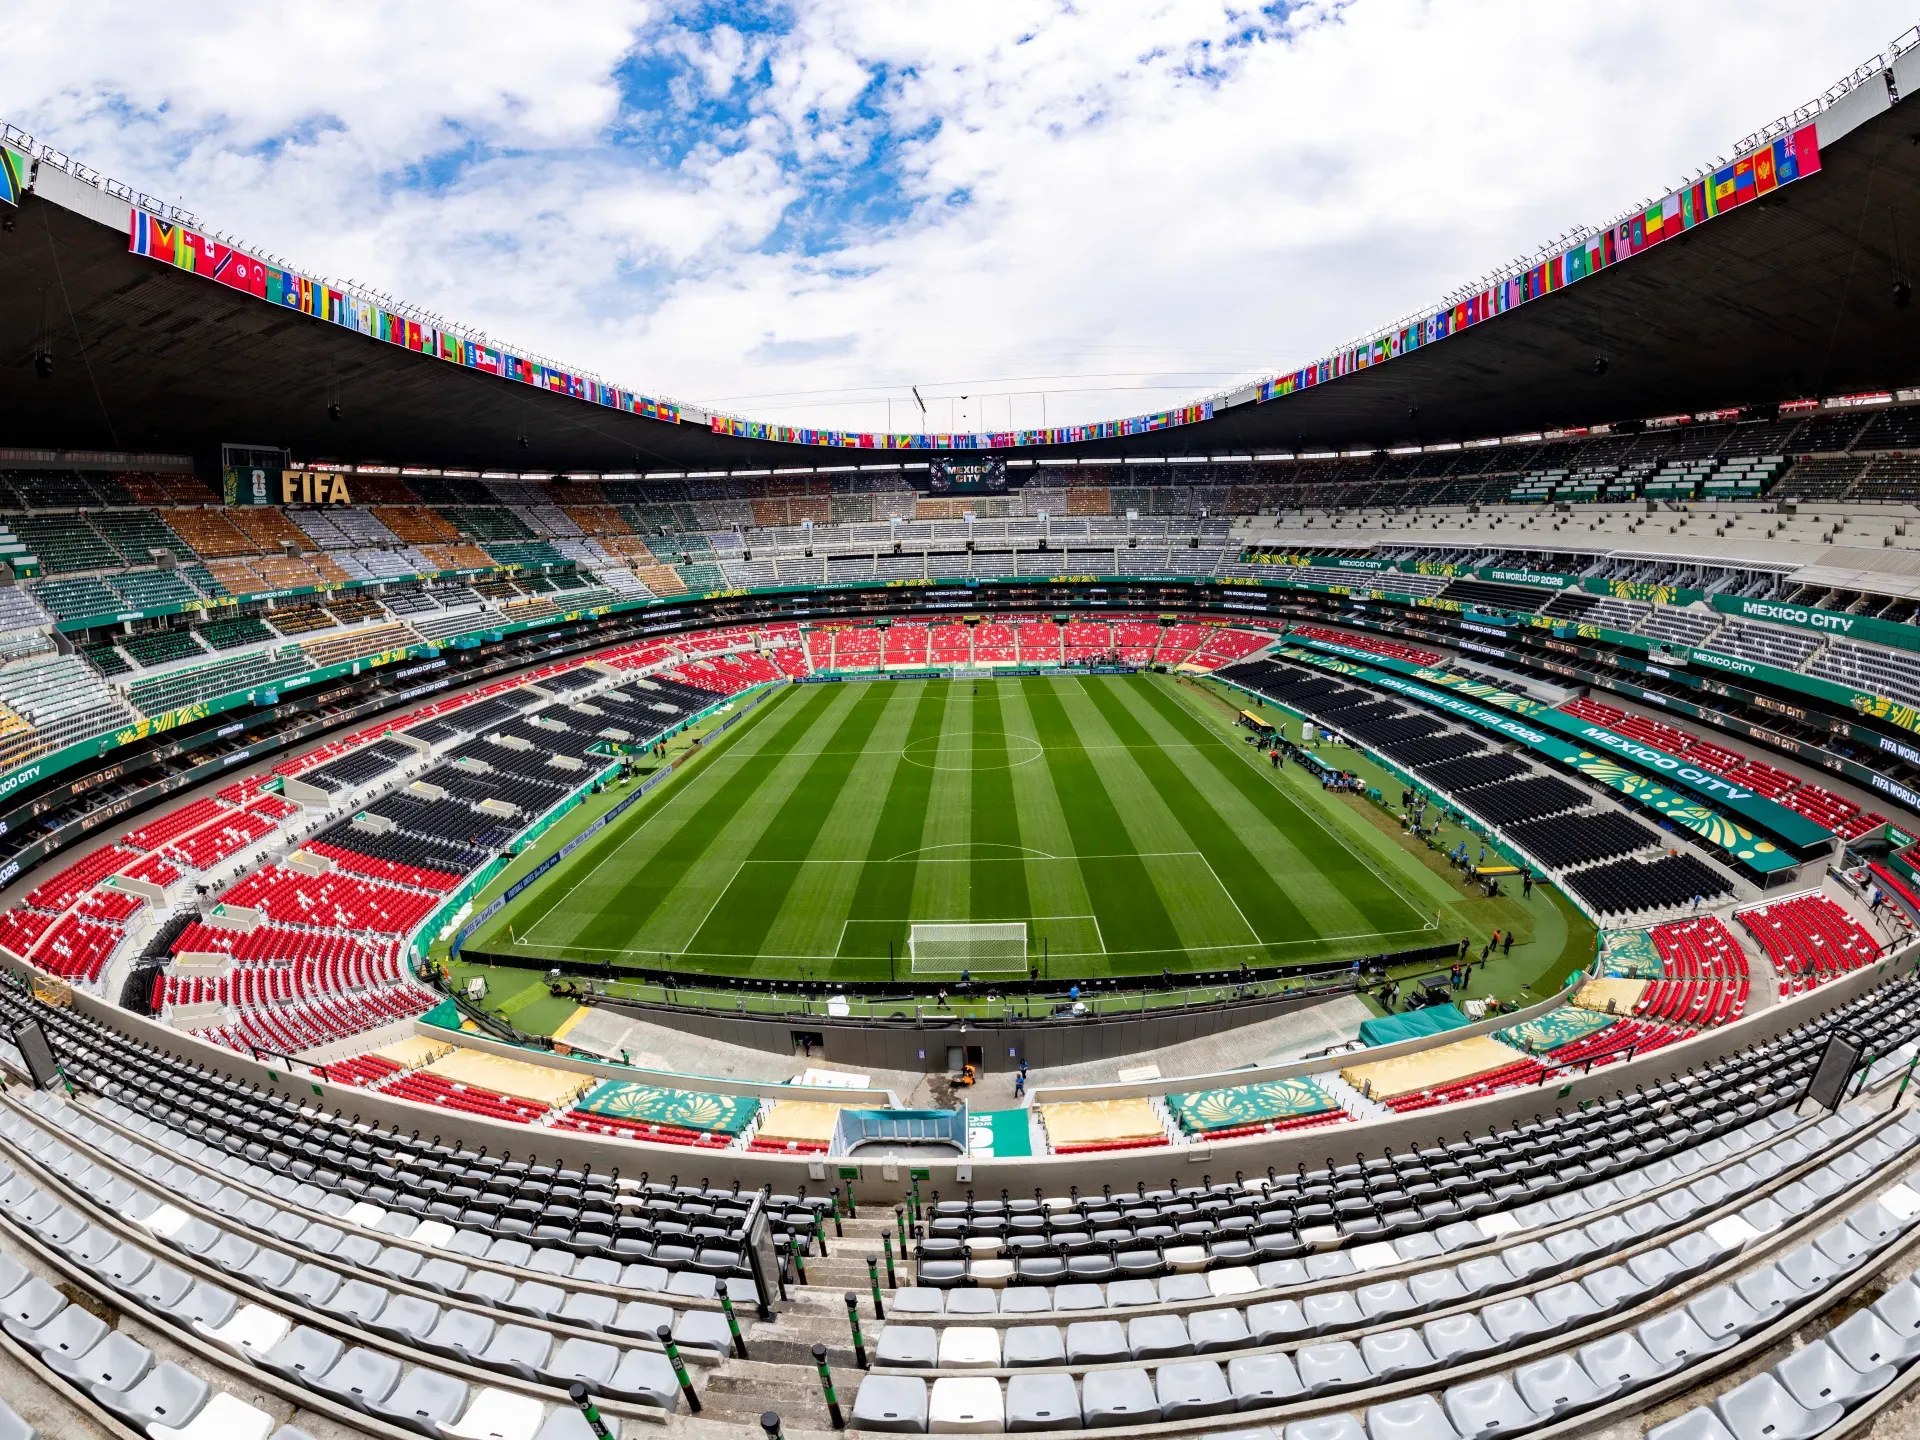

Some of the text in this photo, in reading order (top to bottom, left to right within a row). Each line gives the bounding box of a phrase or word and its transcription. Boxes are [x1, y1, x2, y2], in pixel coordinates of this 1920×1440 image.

[948, 466, 989, 474] MEXICO
[956, 474, 980, 482] CITY
[282, 470, 351, 504] FIFA
[1366, 561, 1382, 569] CITY
[1492, 572, 1564, 586] FIFA WORLD CUP 2026
[252, 591, 277, 600] MEXICO
[527, 620, 544, 628] MEXICO
[1743, 602, 1854, 632] MEXICO CITY
[1469, 624, 1482, 632] WORLD
[1492, 628, 1506, 638] 2026
[1308, 640, 1390, 662] MEXICO CITY
[1468, 643, 1482, 652] WORLD
[1482, 646, 1490, 654] CUP
[1490, 648, 1505, 657] 2026
[407, 667, 422, 676] WORLD
[432, 660, 446, 668] 2026
[1694, 652, 1756, 674] MEXICO CITY
[410, 688, 426, 697] WORLD
[434, 680, 449, 689] 2026
[1379, 678, 1546, 743] COPA MUNDIAL DE LA FIFA 2026
[1754, 696, 1806, 720] MEXICO CITY
[1750, 727, 1801, 752] MEXICO CITY
[1880, 737, 1920, 764] FIFA WORL
[1582, 728, 1752, 800] MEXICO CITY
[18, 766, 40, 784] CITY
[72, 765, 124, 794] MEXICO CITY
[1872, 775, 1916, 805] FIFA WORLD
[82, 798, 132, 830] MEXICO CITY
[0, 822, 8, 835] 6
